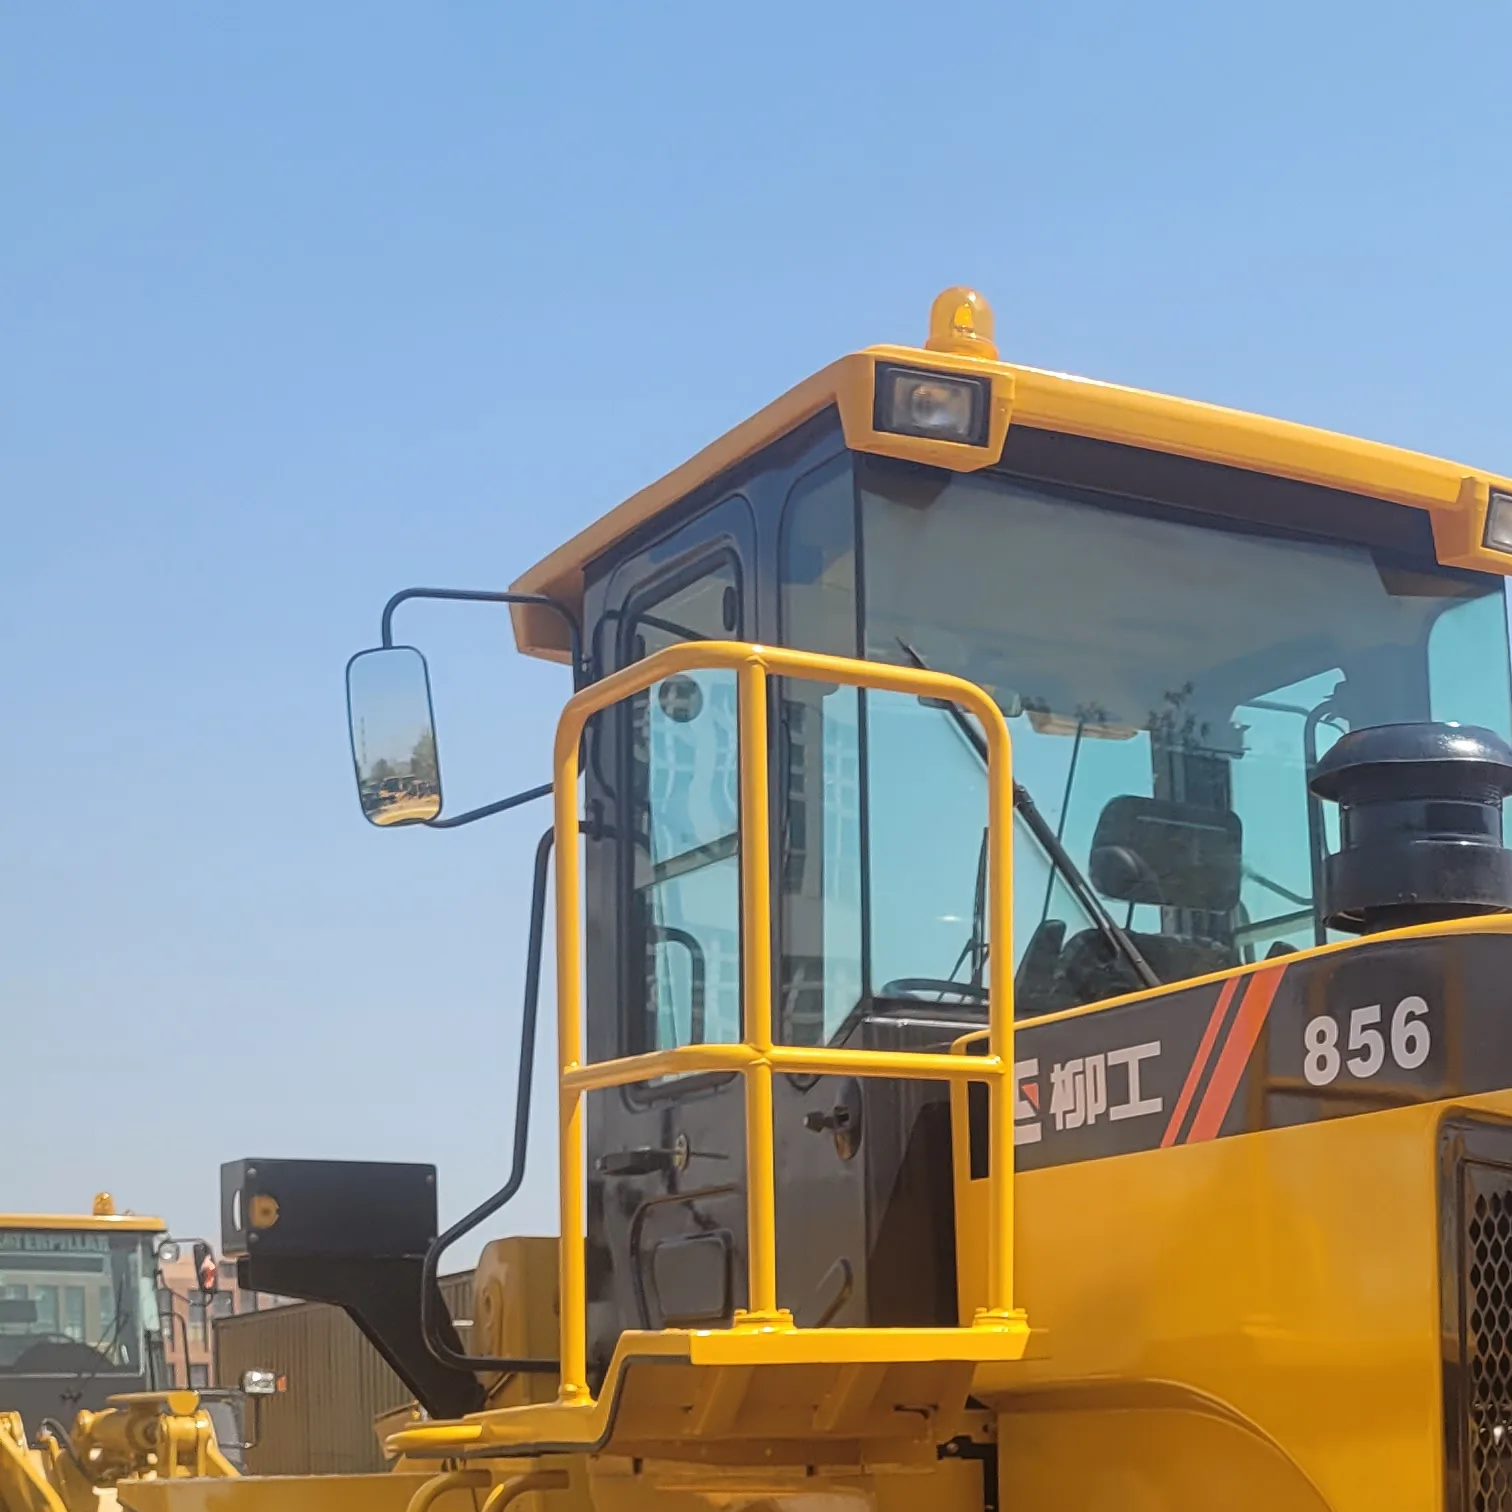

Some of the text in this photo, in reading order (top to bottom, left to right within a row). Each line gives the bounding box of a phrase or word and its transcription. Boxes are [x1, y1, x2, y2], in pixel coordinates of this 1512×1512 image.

[1049, 1040, 1163, 1131] 柳工
[1304, 996, 1431, 1086] 856
[0, 1232, 111, 1252] ATERPILLAR
